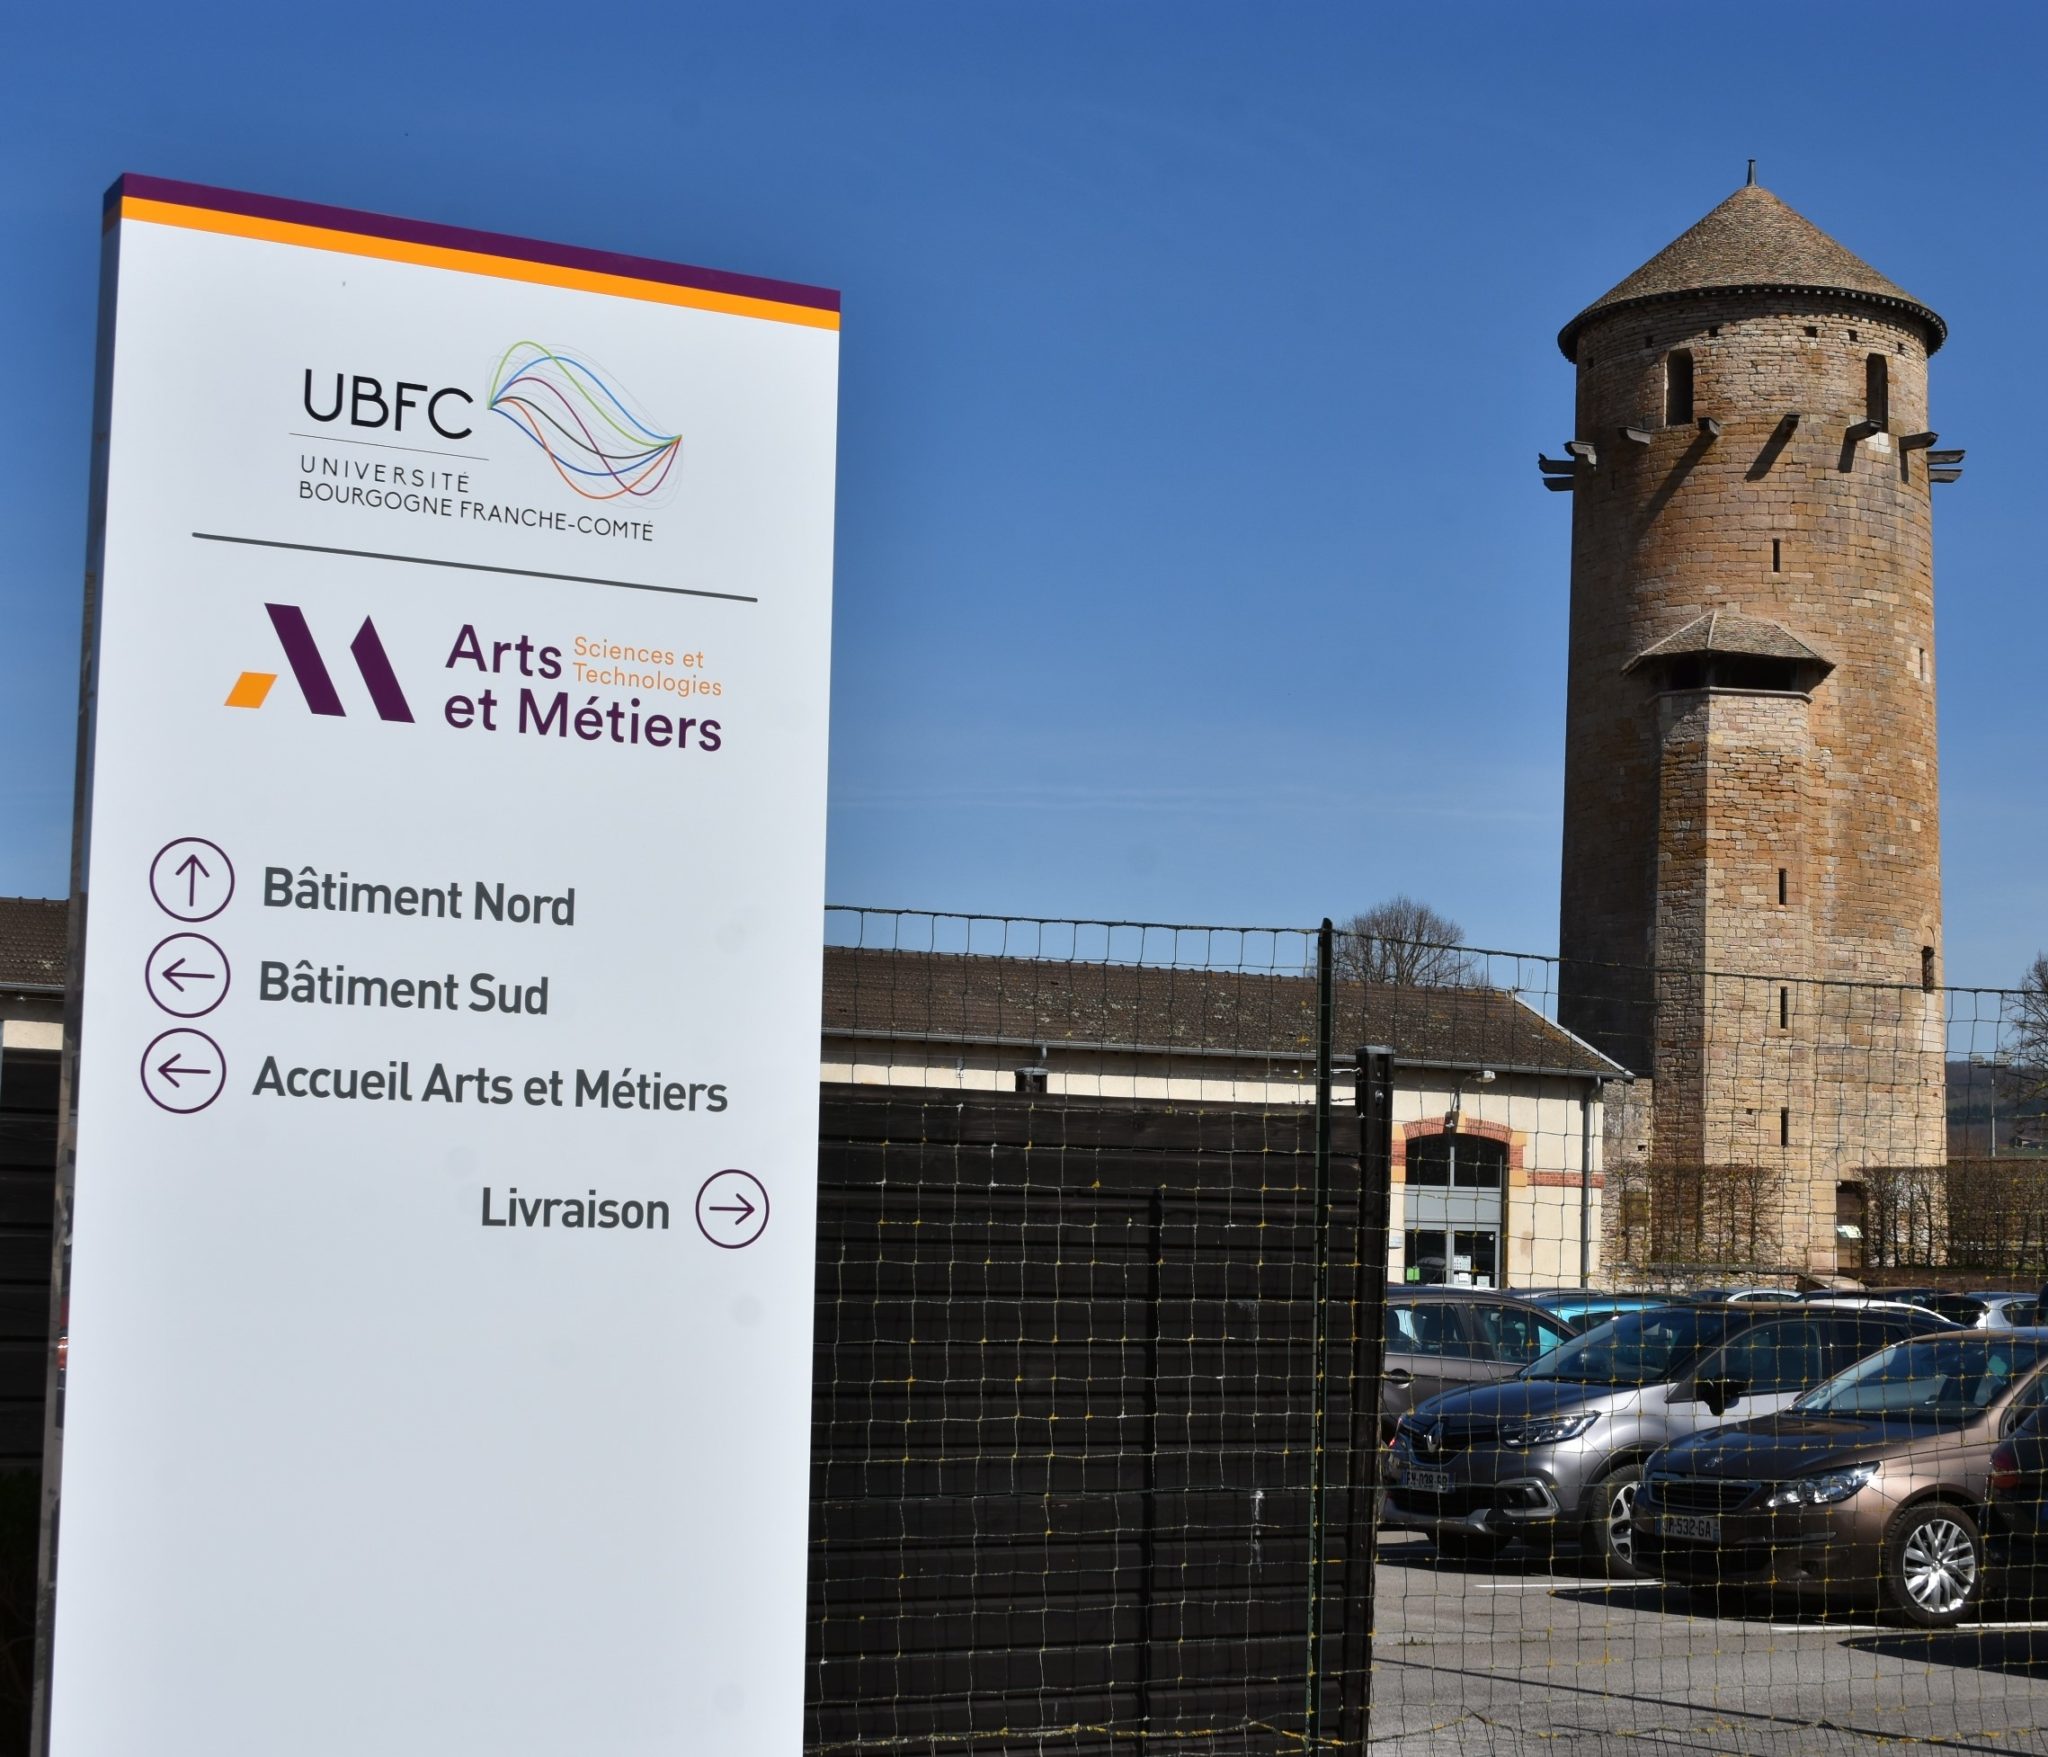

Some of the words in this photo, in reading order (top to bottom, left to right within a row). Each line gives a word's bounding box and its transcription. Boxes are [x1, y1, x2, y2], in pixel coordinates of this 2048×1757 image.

[304, 368, 474, 440] UBFC
[301, 454, 470, 494] UNIVERSITÉ
[299, 480, 453, 518] BOURGOGNE
[460, 501, 654, 542] FRANCHE-COMTÉ
[445, 623, 564, 680] Arts
[573, 636, 675, 667] Sciences
[682, 651, 704, 669] et
[573, 662, 723, 698] Technologies
[444, 690, 498, 732] et
[518, 687, 723, 753] Métiers
[263, 865, 462, 920] Bâtiment
[475, 881, 576, 927] Nord
[259, 959, 459, 1013] Bâtiment
[468, 972, 549, 1016] Sud
[251, 1055, 413, 1102] Accueil
[421, 1062, 513, 1106] Arts
[523, 1070, 564, 1108] et
[575, 1067, 729, 1113] Métiers
[481, 1187, 669, 1231] Livraison
